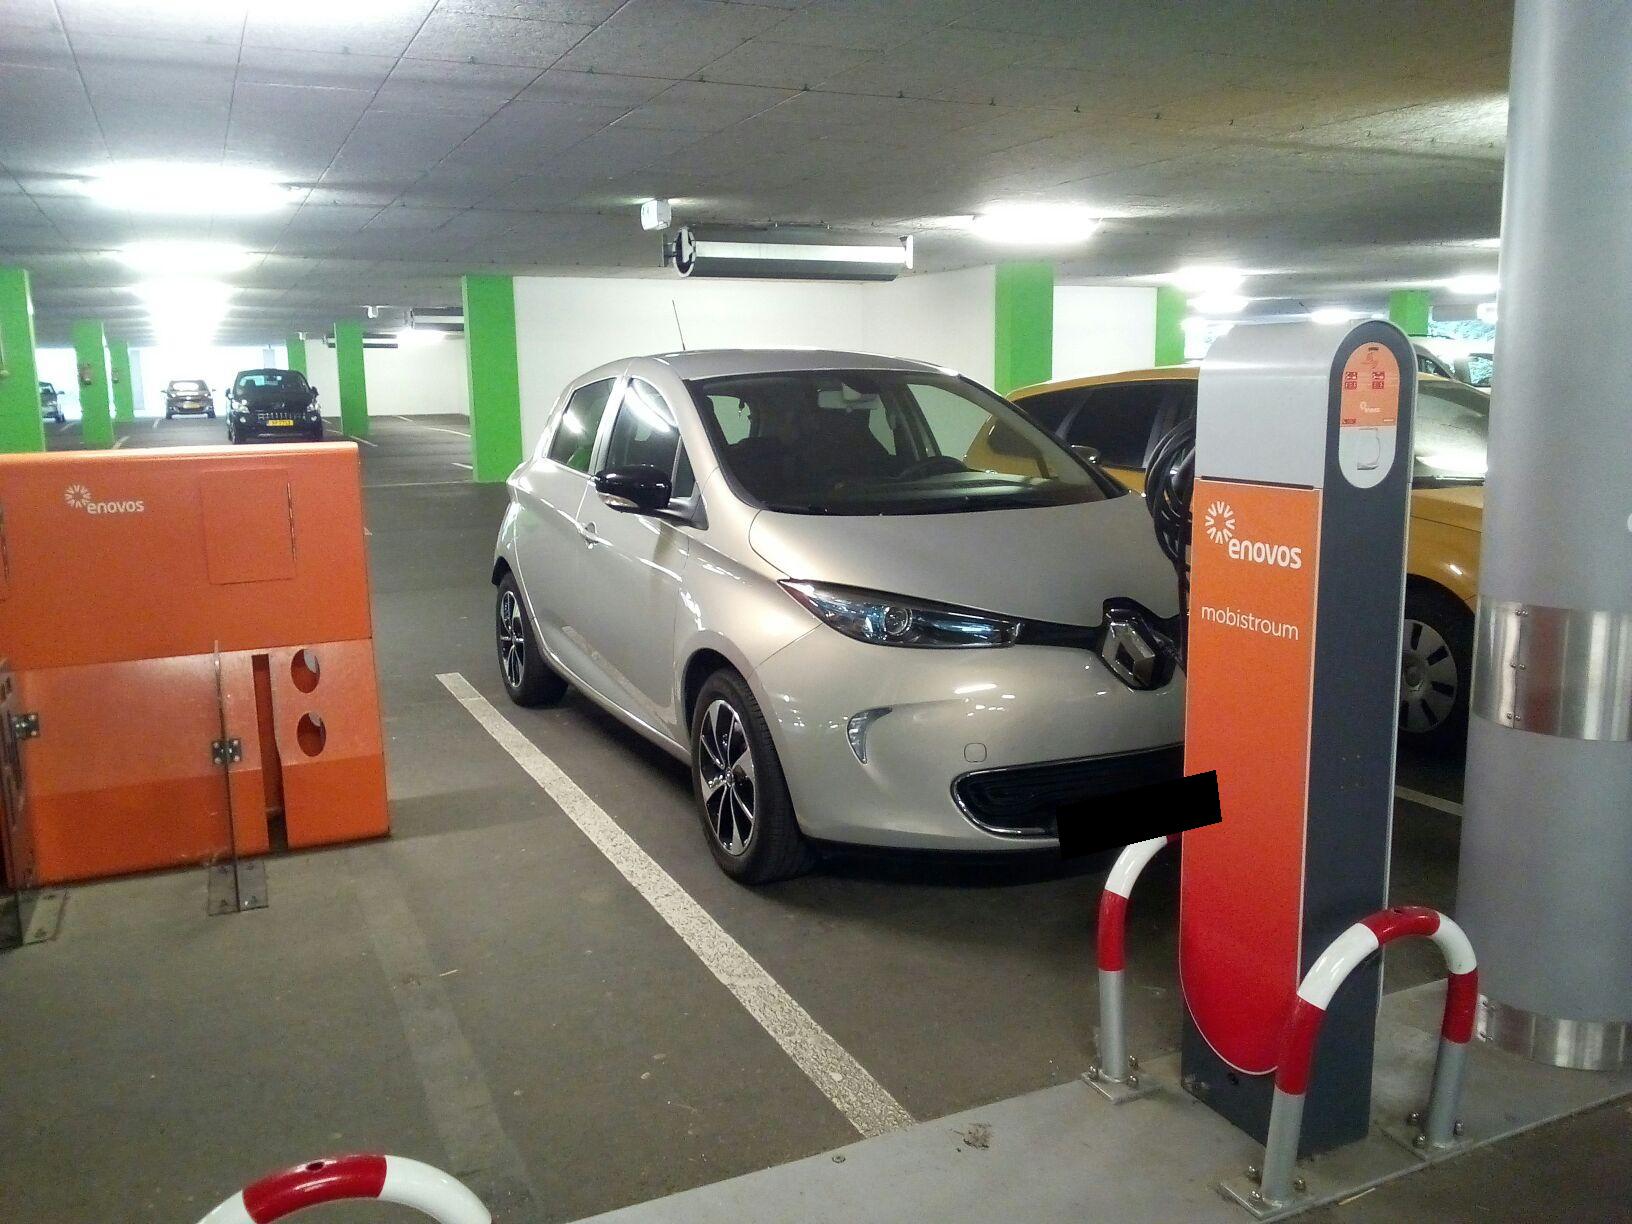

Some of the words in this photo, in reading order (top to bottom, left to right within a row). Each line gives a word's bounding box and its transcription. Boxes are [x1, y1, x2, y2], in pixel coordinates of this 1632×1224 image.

[86, 500, 145, 514] enovos
[1228, 538, 1302, 569] enovos
[1201, 606, 1299, 640] mobistroum
